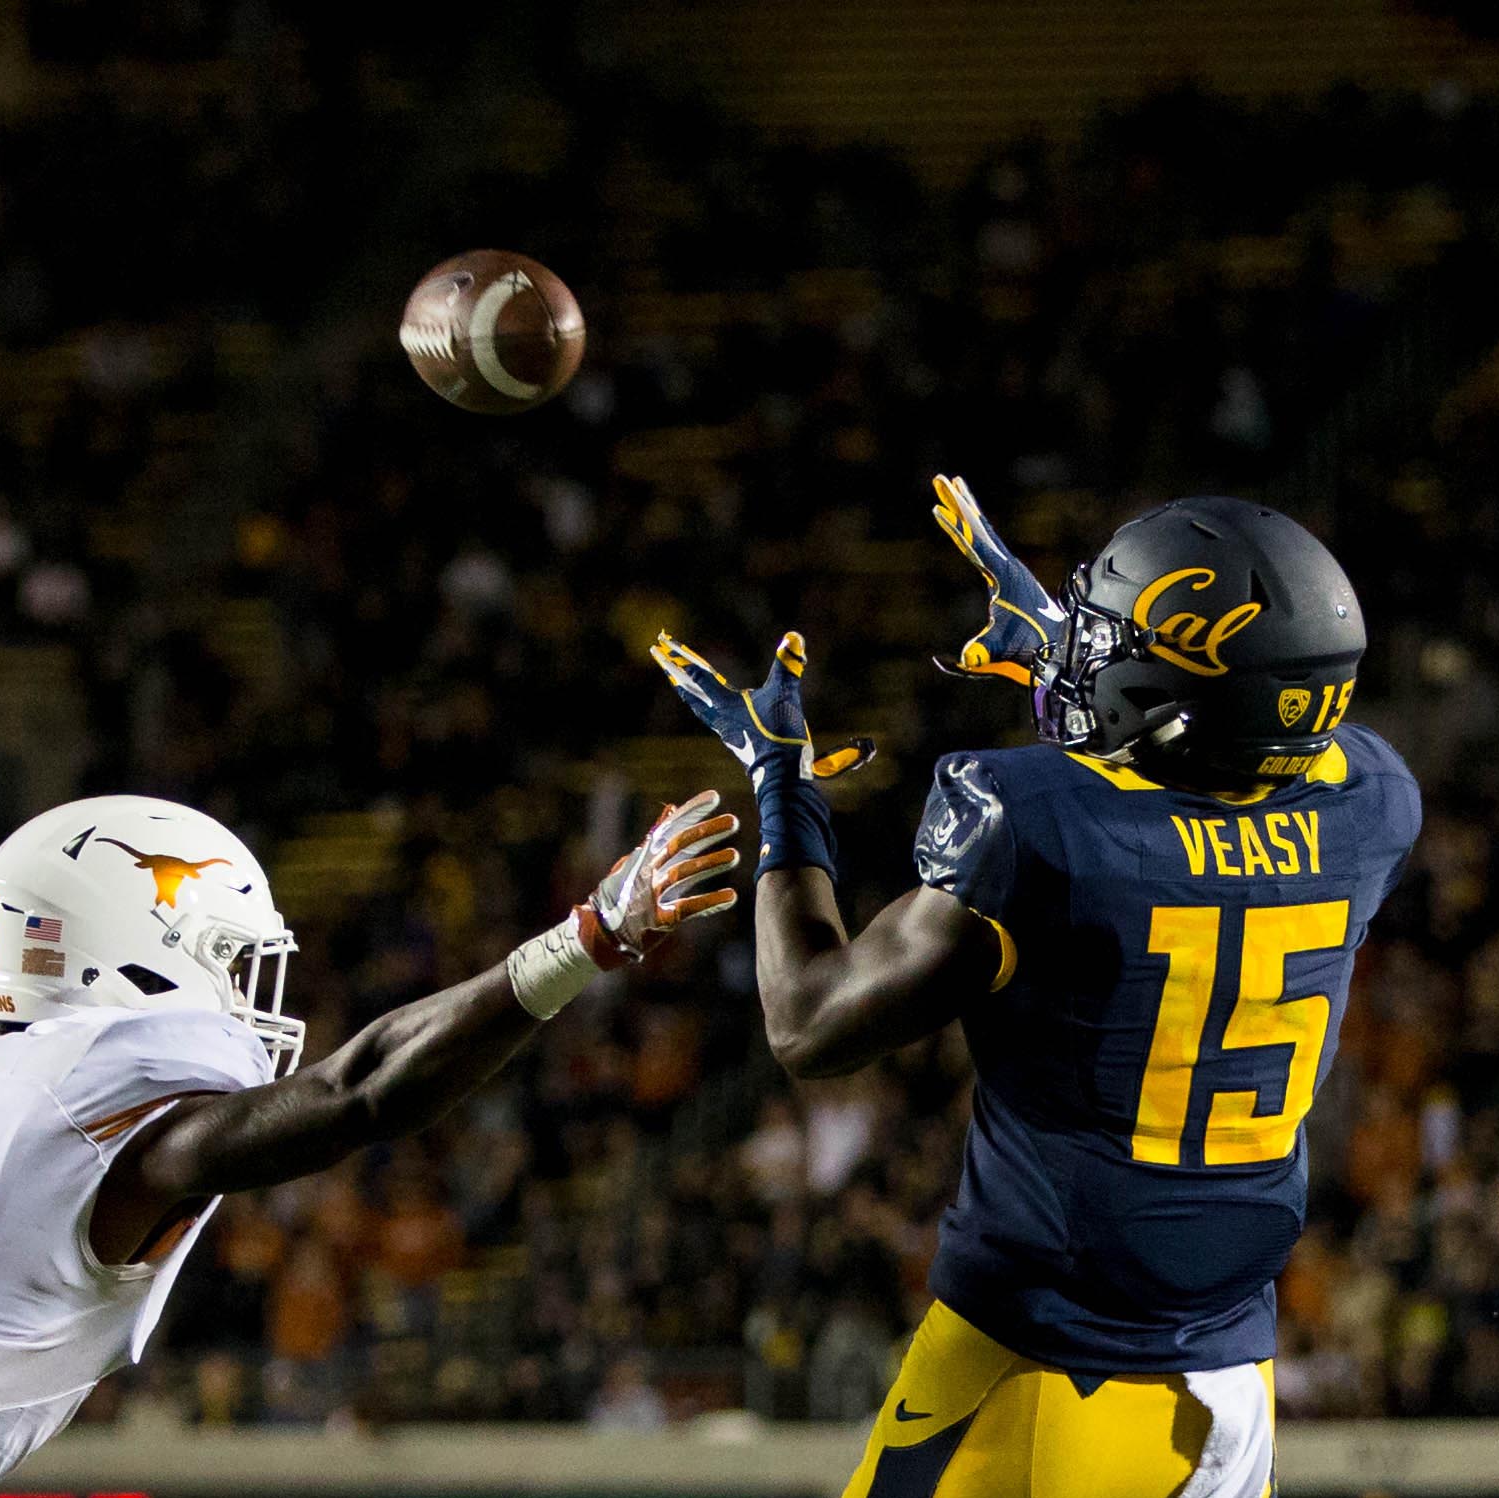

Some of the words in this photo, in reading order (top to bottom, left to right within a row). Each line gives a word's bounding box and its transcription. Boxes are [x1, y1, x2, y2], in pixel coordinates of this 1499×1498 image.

[1132, 567, 1262, 677] Cal
[1170, 810, 1322, 877] VEASY
[1131, 899, 1350, 1166] 15
